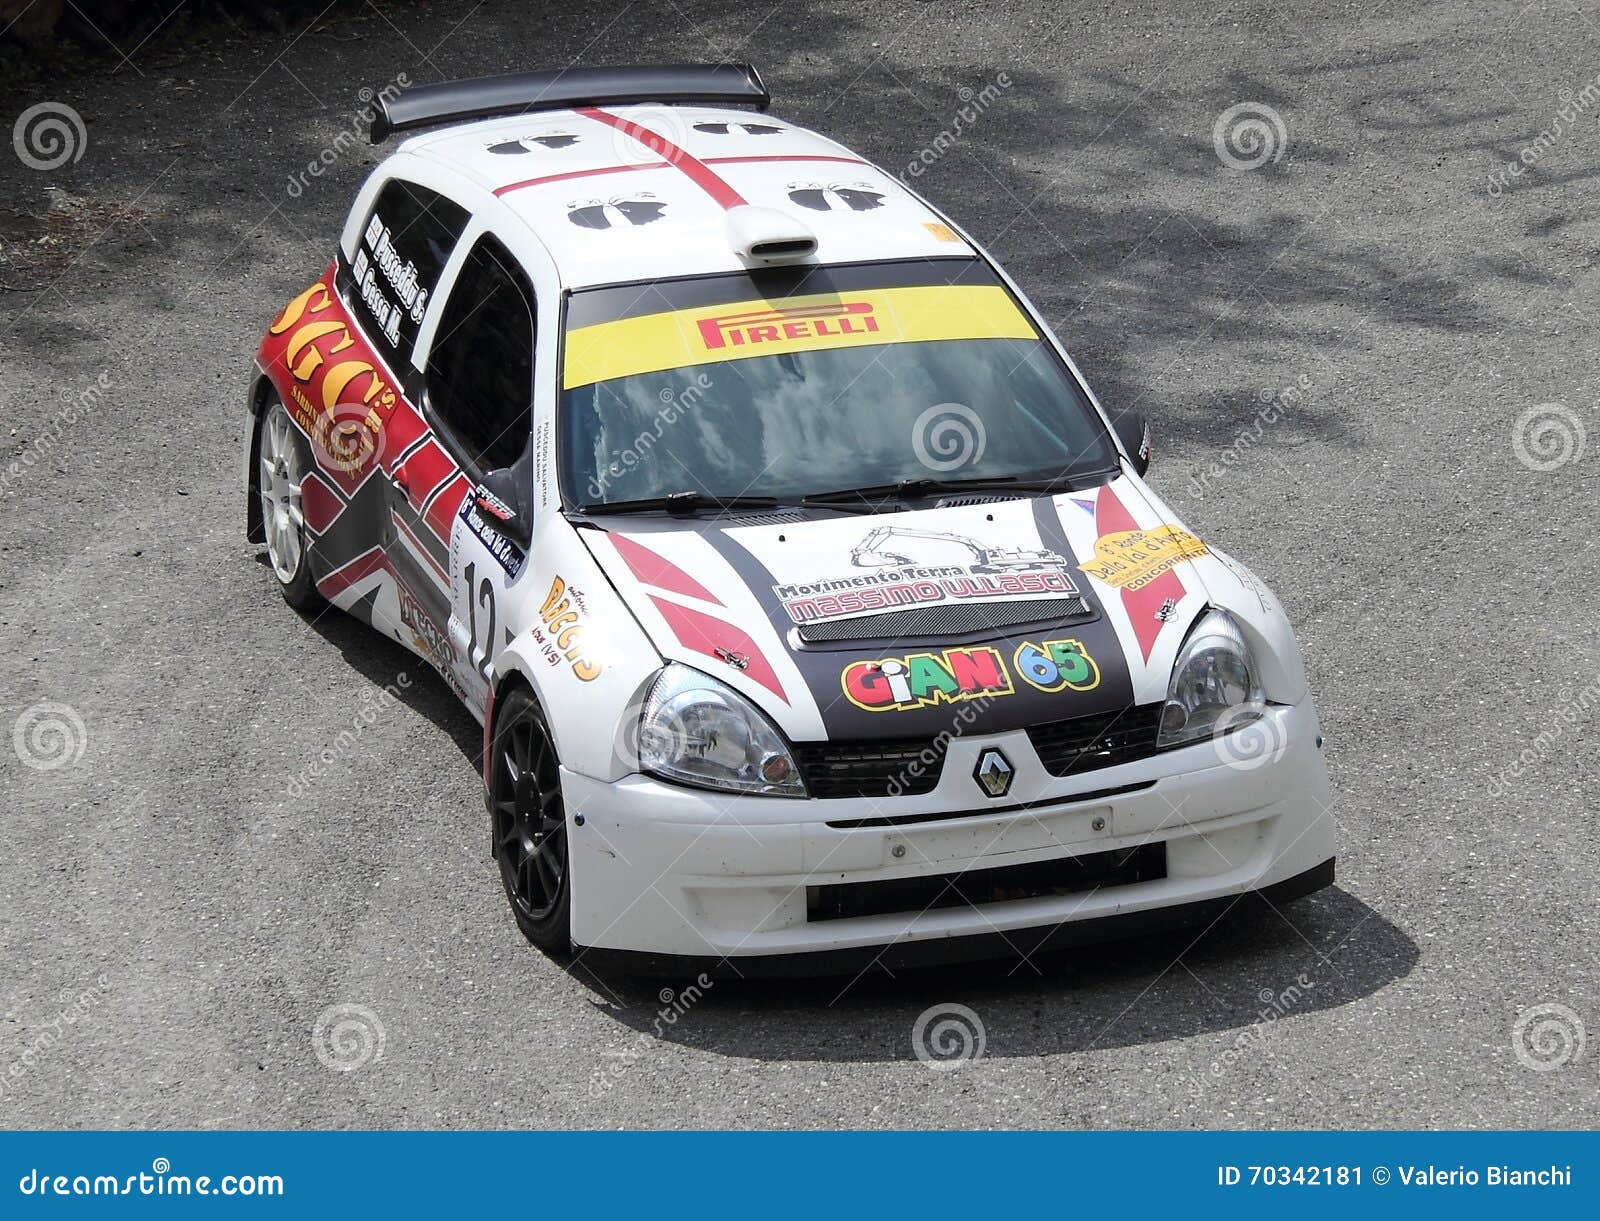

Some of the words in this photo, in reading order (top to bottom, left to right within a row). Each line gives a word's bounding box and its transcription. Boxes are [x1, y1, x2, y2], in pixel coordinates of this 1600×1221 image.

[696, 302, 880, 350] PIRELLI
[270, 282, 384, 434] SGC
[775, 571, 900, 600] Movimento
[903, 564, 964, 581] Terra
[1126, 547, 1210, 590] CONCORRENTE
[464, 561, 496, 685] 12
[1013, 639, 1100, 692] 65
